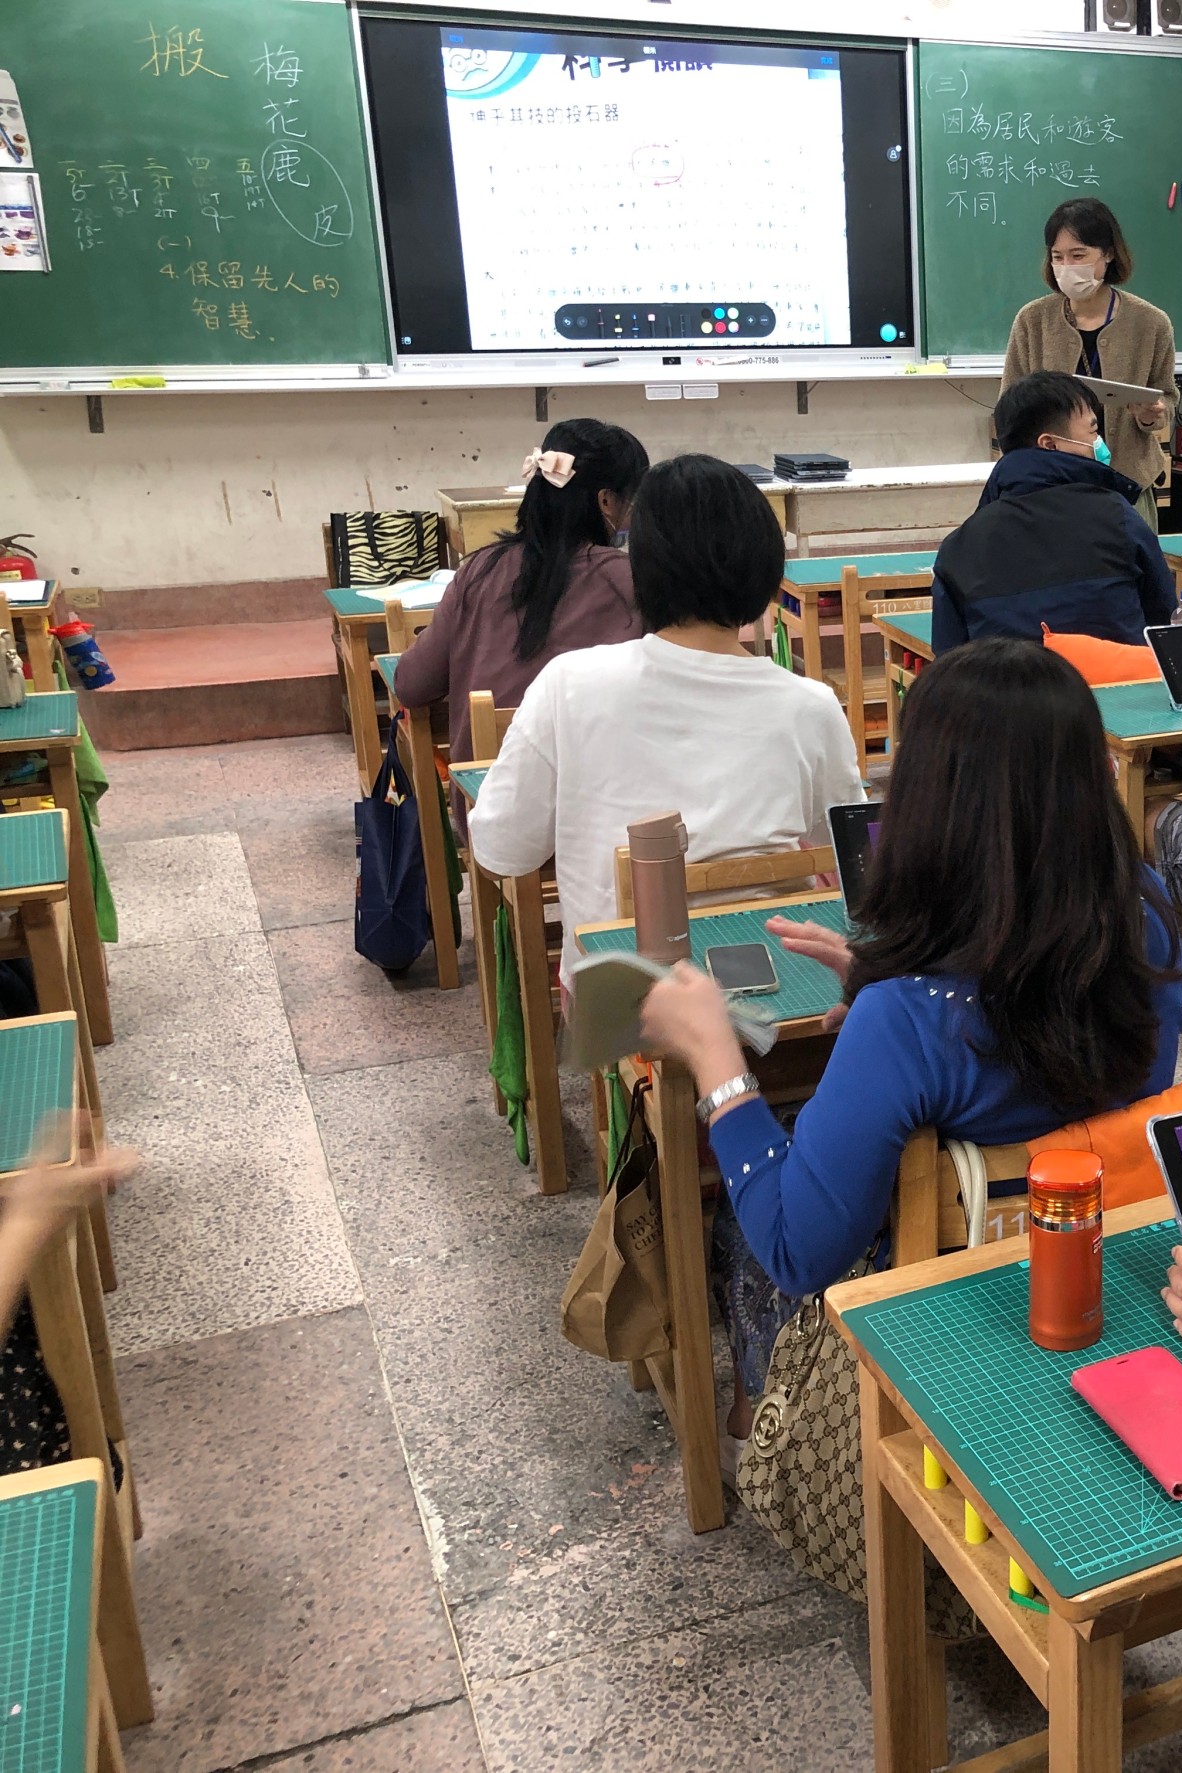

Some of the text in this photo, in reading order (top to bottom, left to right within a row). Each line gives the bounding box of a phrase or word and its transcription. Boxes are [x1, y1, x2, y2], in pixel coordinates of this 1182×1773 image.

[134, 21, 229, 78] 搬
[942, 103, 1124, 146] 因為居民和遊客
[946, 151, 1101, 188] 的需求和過去
[873, 602, 897, 615] 110
[989, 1211, 1025, 1240] 11
